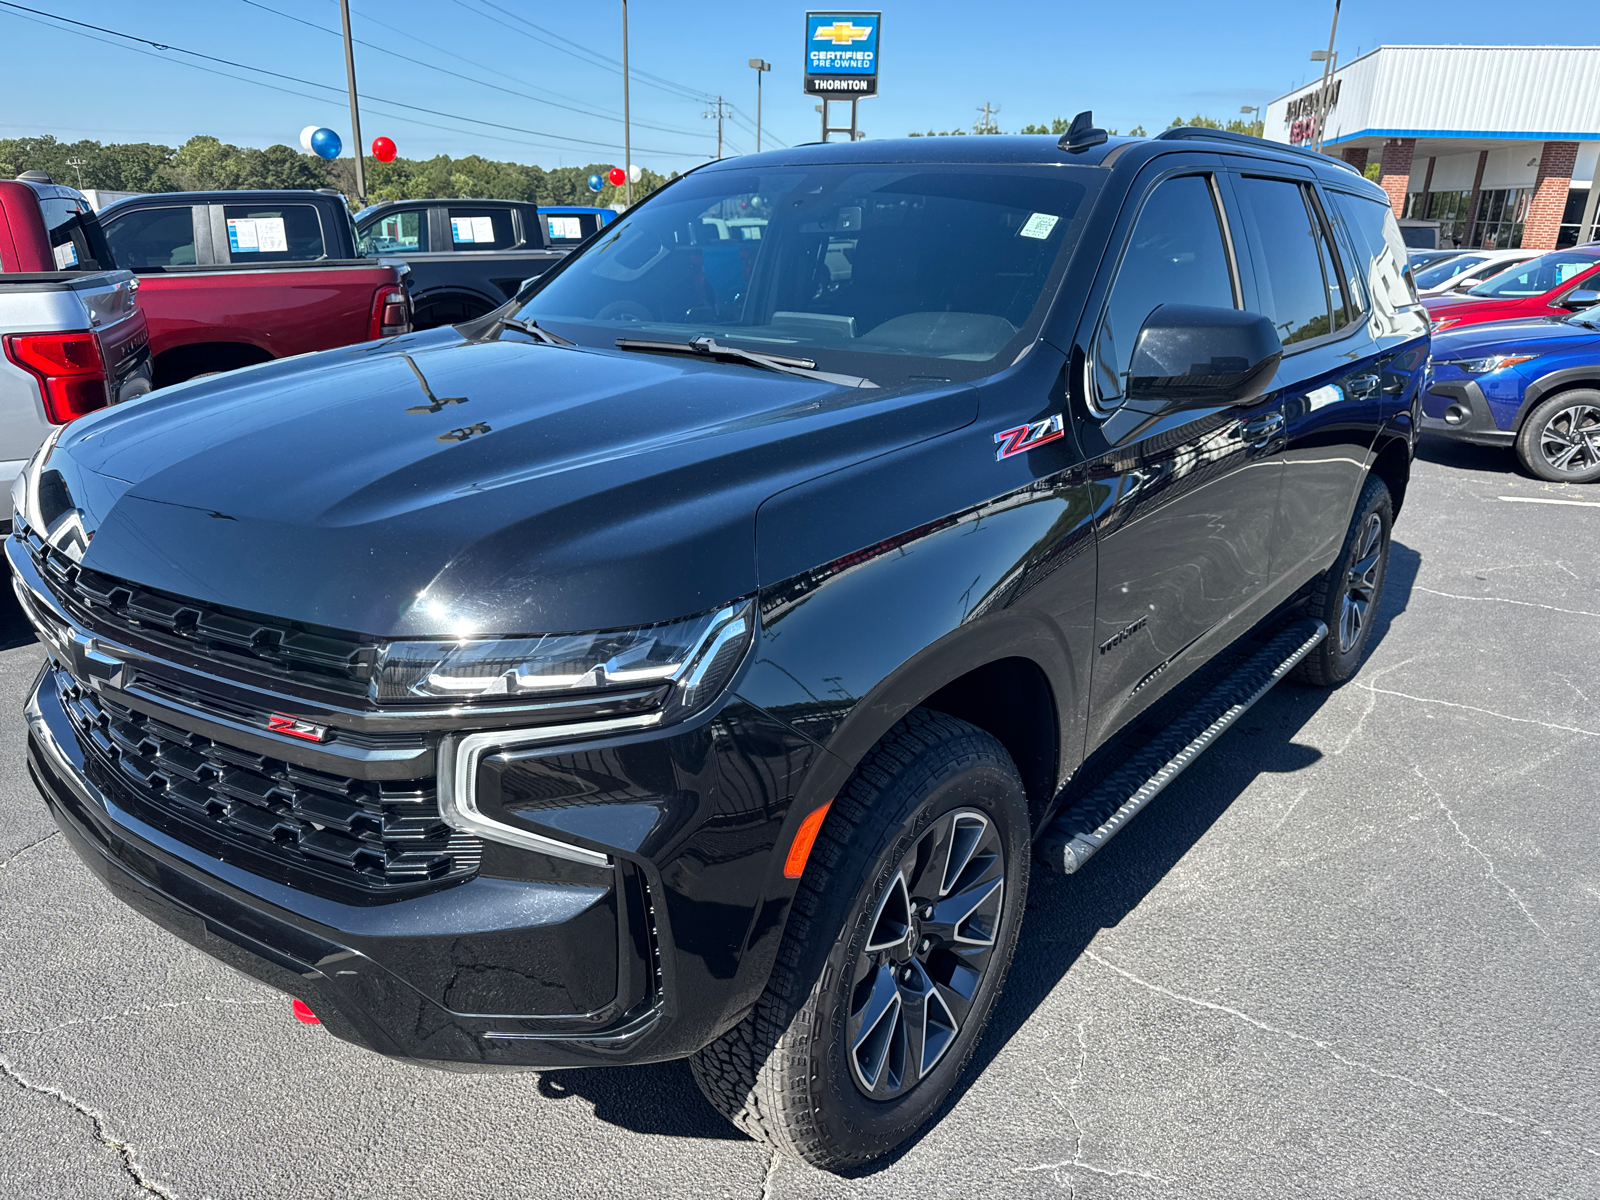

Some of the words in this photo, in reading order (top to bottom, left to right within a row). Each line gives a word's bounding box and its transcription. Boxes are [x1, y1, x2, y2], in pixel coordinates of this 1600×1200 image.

[810, 51, 873, 60] CERTIFIED
[813, 60, 870, 68] PRE-OWNED
[814, 80, 868, 90] THORNTON
[993, 412, 1065, 461] Z71
[267, 712, 326, 742] Z71
